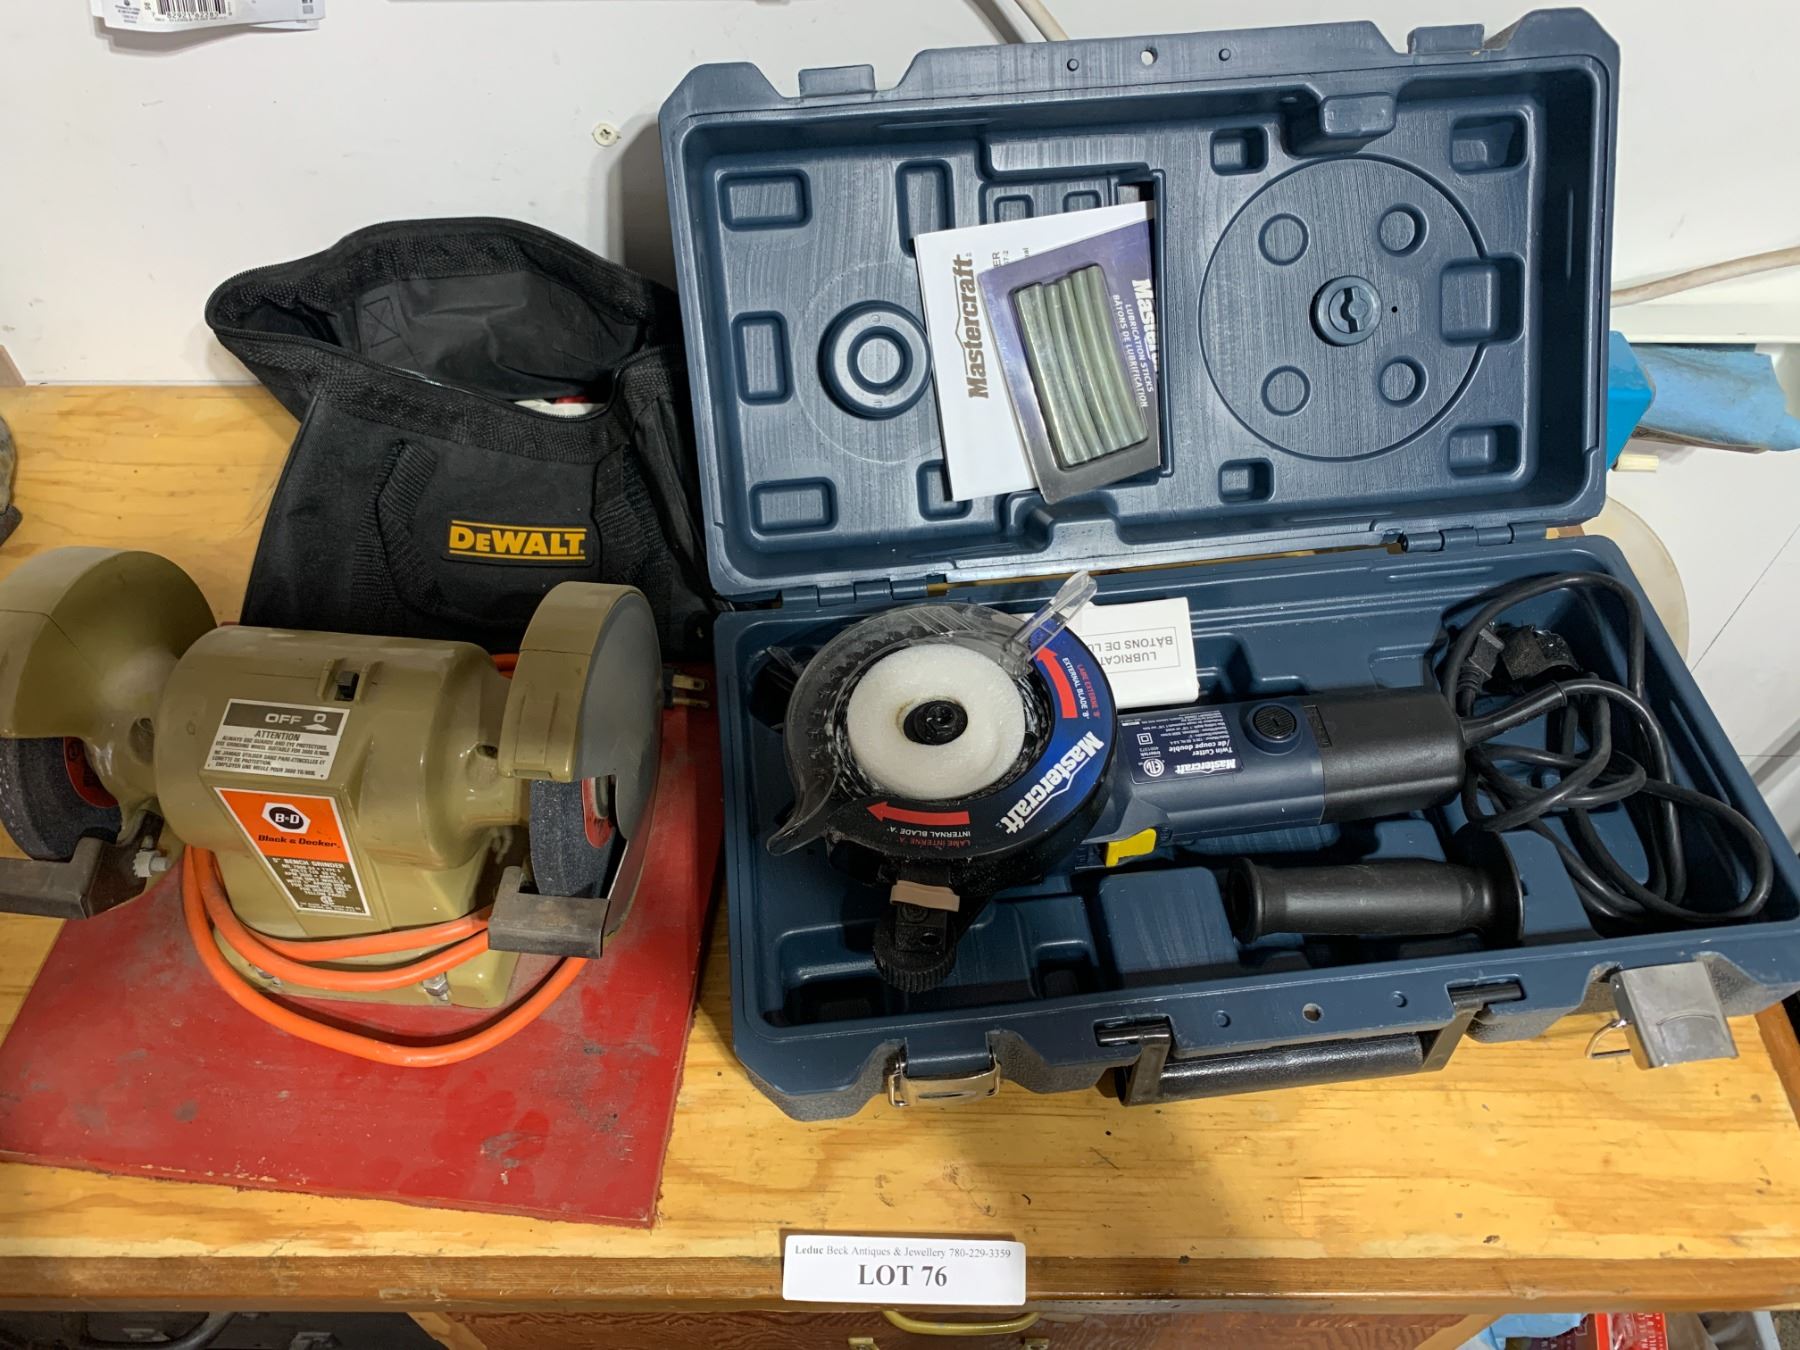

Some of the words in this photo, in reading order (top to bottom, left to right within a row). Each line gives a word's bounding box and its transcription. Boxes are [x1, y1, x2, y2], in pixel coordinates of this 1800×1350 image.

[952, 254, 989, 399] Mastercraft
[1123, 331, 1131, 342] DE
[1125, 304, 1146, 363] LUBRICATION
[1140, 363, 1153, 392] STICKS
[1126, 344, 1149, 408] LUBRIFICATION
[1105, 642, 1120, 650] DE
[1101, 652, 1156, 665] LUBRICAT
[1062, 658, 1081, 688] EXTERNAL
[1077, 689, 1088, 709] BLADE
[265, 713, 303, 725] OFF
[254, 730, 300, 741] ATTENTION
[1168, 744, 1194, 752] double
[1192, 748, 1214, 756] Cutter
[1174, 759, 1236, 774] Mastercraft
[1000, 730, 1105, 834] Mastercraft
[900, 828, 927, 837] BLADE
[258, 835, 287, 843] Black
[299, 838, 336, 847] Decker
[795, 1245, 823, 1255] Leduc
[826, 1245, 849, 1255] Beck
[851, 1246, 891, 1258] Antiques
[893, 1247, 901, 1256] &
[903, 1247, 946, 1259] Jewellery
[949, 1248, 1011, 1258] 780-229-3359
[858, 1264, 914, 1286] LOT
[921, 1266, 947, 1287] 76
